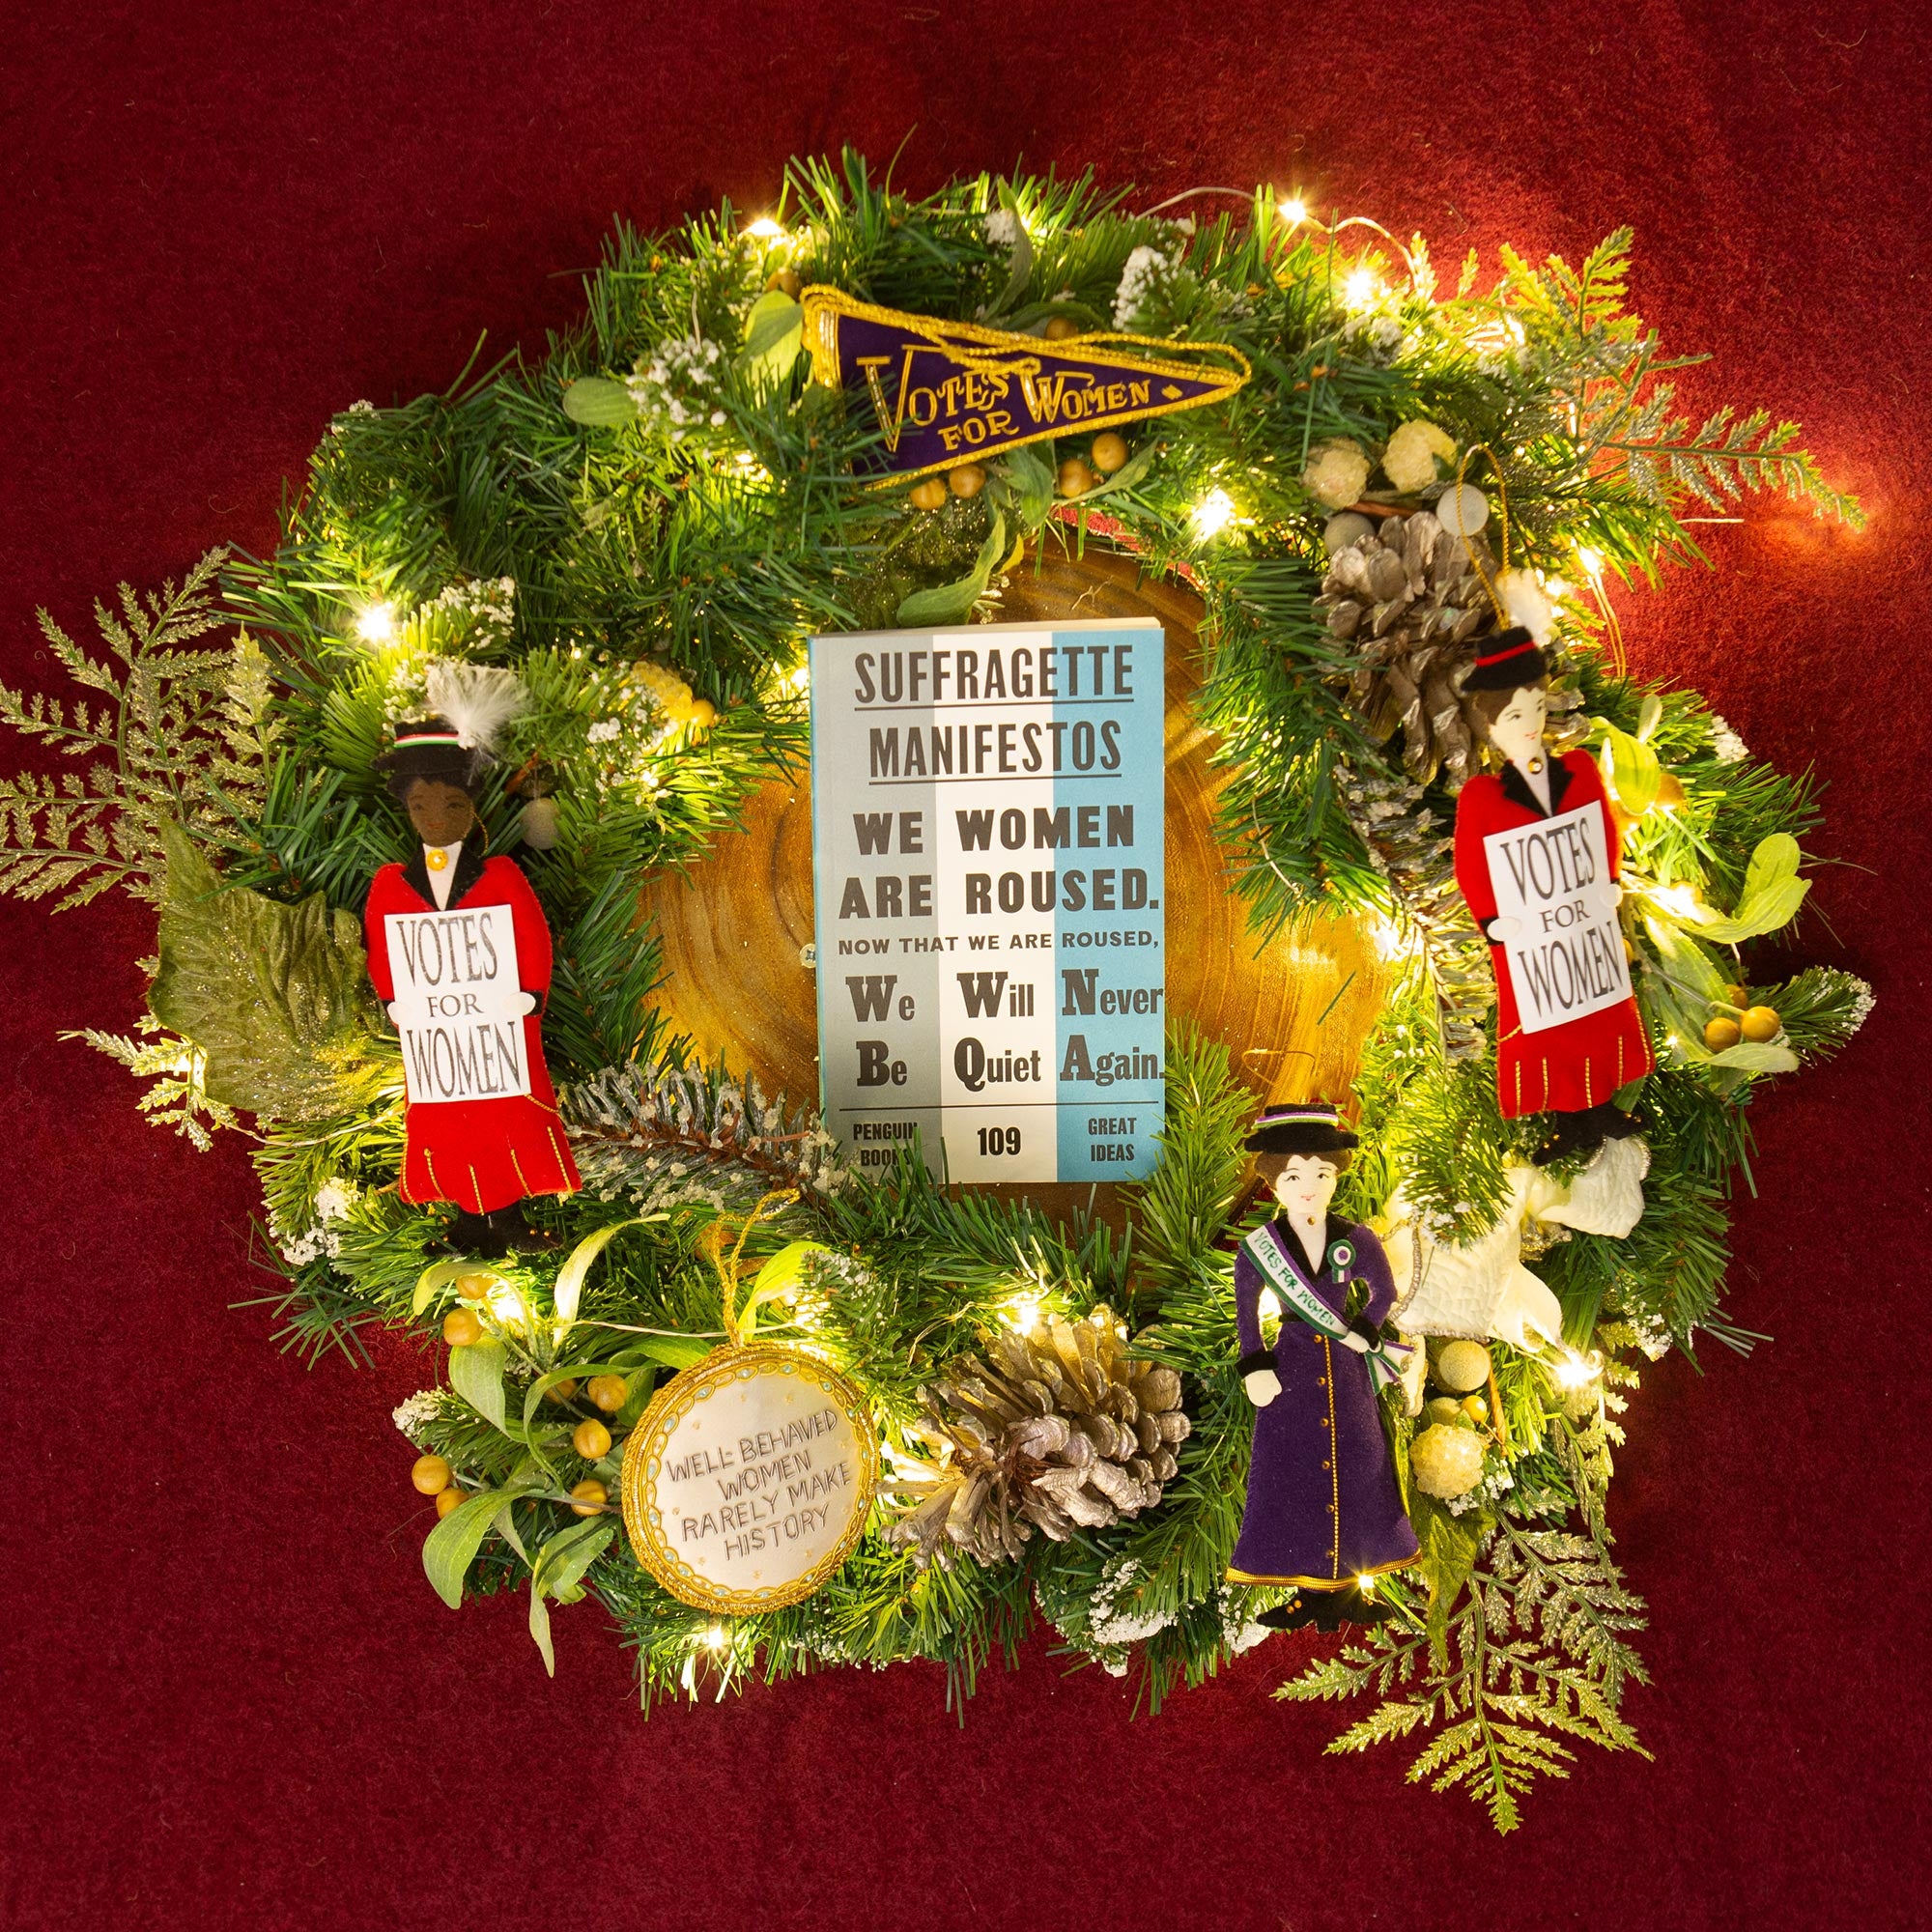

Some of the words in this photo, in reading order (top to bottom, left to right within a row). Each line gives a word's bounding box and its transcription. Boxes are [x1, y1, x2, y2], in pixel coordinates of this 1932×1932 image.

[856, 345, 1009, 452] VOTES
[938, 411, 1019, 451] FOR
[1018, 368, 1151, 424] WOMEN
[855, 644, 1133, 703] SUFFRAGETTE
[868, 721, 1121, 778] MANIFESTOS
[853, 811, 923, 856] WE
[955, 805, 1134, 851] WOMEN
[1500, 817, 1594, 906] VOTES
[838, 875, 933, 920] ARE
[966, 869, 1159, 915] ROUSED.
[1539, 899, 1591, 933] FOR
[396, 912, 497, 986] VOTES
[838, 939, 890, 955] NOW
[899, 936, 958, 953] THAT
[969, 935, 1000, 951] WE
[1009, 933, 1052, 949] ARE
[1063, 931, 1159, 949] ROUSED,
[1518, 921, 1623, 1017] WOMEN
[426, 993, 483, 1017] FOR
[845, 975, 915, 1023] We
[956, 971, 1034, 1018] Will
[1062, 968, 1163, 1015] Never
[407, 1021, 521, 1097] WOMEN
[856, 1040, 907, 1087] Be
[954, 1037, 1041, 1093] Quiet
[1060, 1035, 1164, 1087] Again.
[978, 1126, 1021, 1155] 109
[1088, 1118, 1137, 1135] GREAT
[1091, 1145, 1134, 1162] IDEAS
[1254, 1232, 1282, 1268] VOTES
[1278, 1267, 1297, 1290] FOR
[1297, 1291, 1335, 1325] WOMEN
[682, 1492, 778, 1542] RARELY
[788, 1462, 851, 1507] MAKE
[717, 1449, 811, 1500] WOMEN
[724, 1501, 830, 1560] HISTORY
